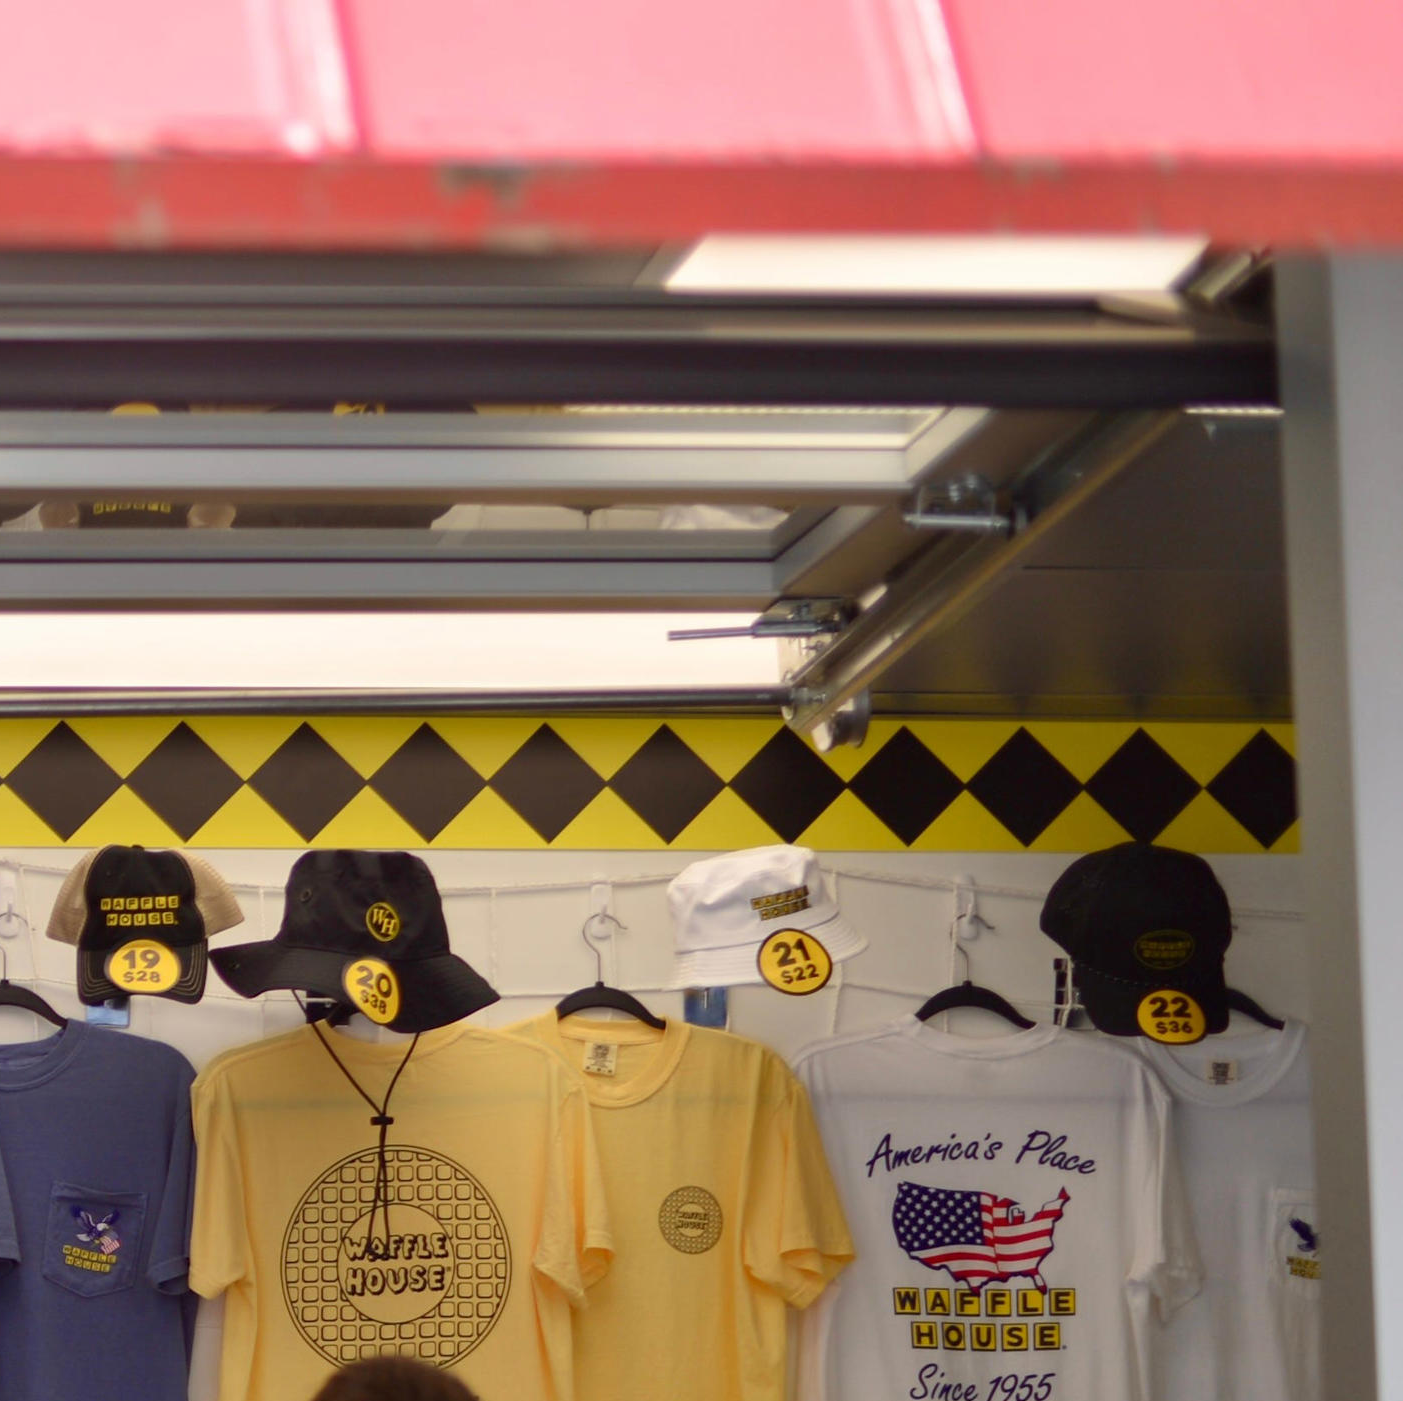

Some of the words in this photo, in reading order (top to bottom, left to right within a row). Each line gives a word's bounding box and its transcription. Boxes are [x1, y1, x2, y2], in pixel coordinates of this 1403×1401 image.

[101, 896, 179, 911] WAFFLE
[106, 912, 174, 926] HOUSE
[123, 950, 160, 969] 19
[772, 938, 810, 967] 21
[123, 971, 161, 983] $28
[356, 966, 392, 999] 20
[782, 964, 819, 984] $22
[361, 989, 387, 1015] $38
[1149, 997, 1192, 1018] 22
[1156, 1021, 1193, 1034] $36
[866, 1132, 1003, 1178] America's
[1016, 1130, 1097, 1175] Place
[345, 1264, 446, 1296] HOUSE
[894, 1289, 1075, 1315] WAFFLE
[913, 1323, 1060, 1350] HOUSE
